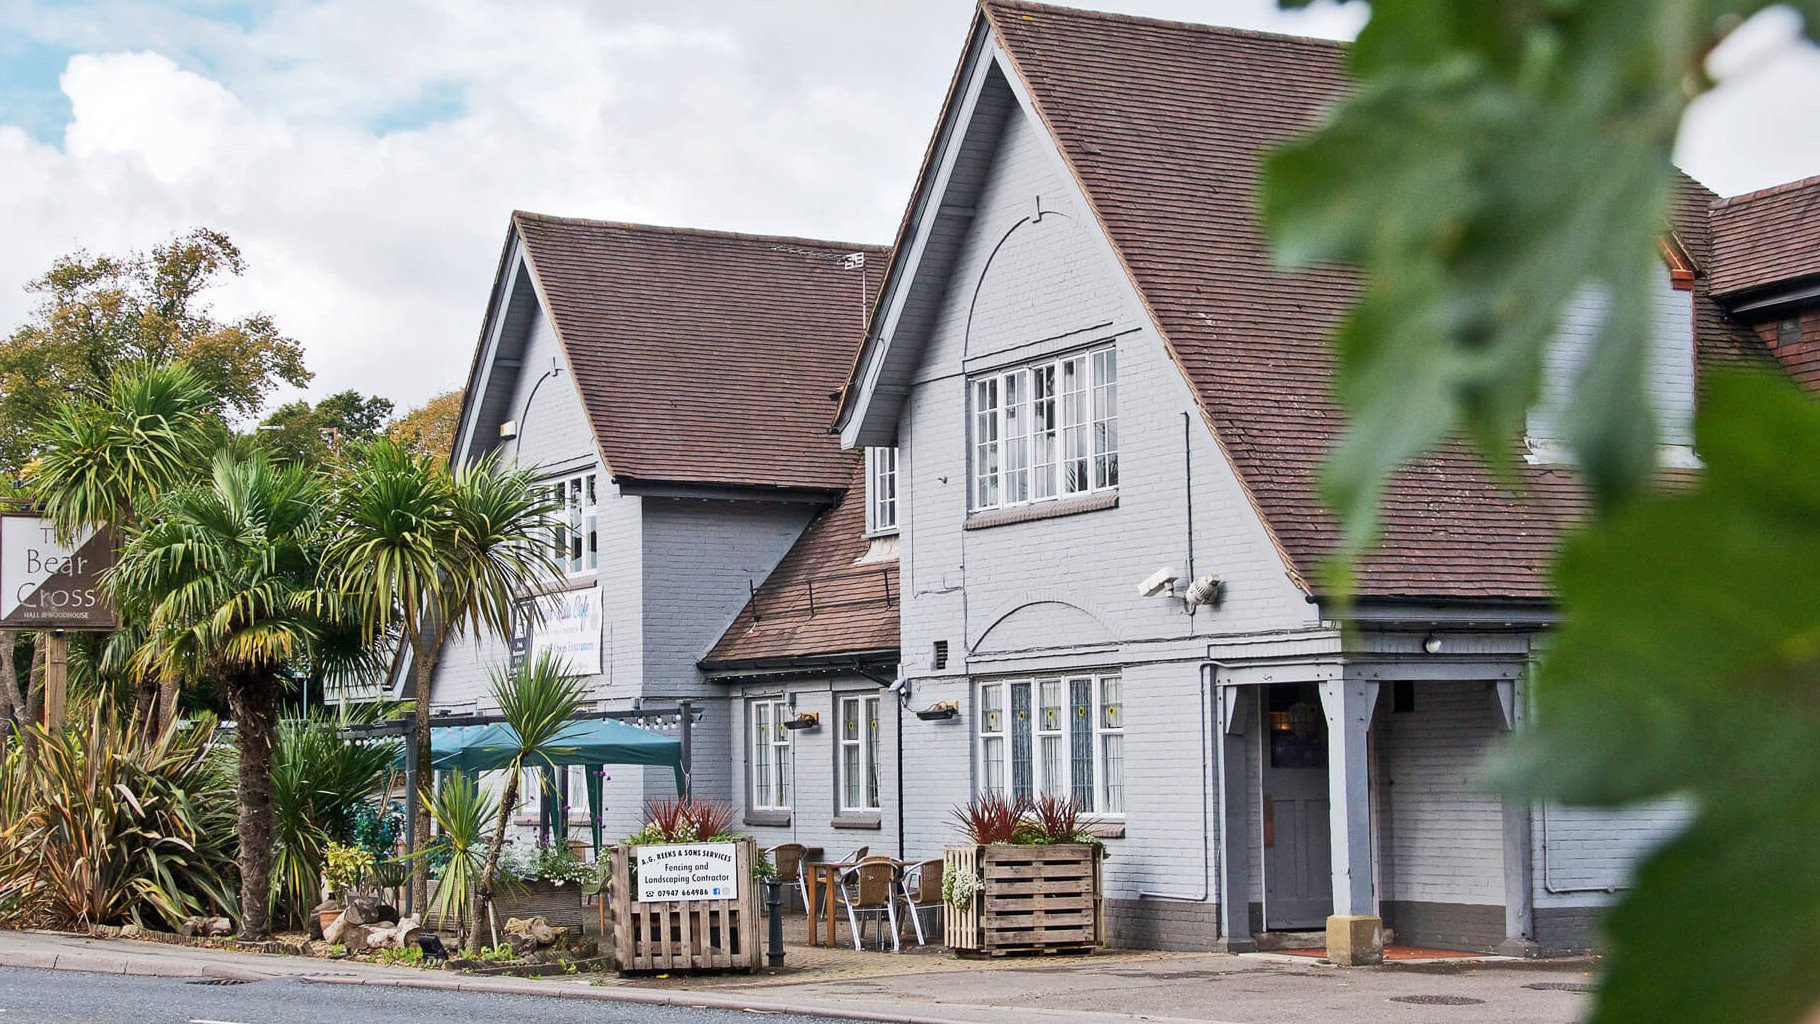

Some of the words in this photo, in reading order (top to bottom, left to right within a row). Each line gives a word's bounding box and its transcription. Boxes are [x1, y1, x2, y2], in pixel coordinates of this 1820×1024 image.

[27, 549, 88, 577] Bear
[16, 582, 96, 608] Cross
[24, 611, 39, 619] HALL
[48, 611, 89, 619] WOODHOUSE
[657, 850, 676, 860] REEKS
[684, 849, 701, 857] SONS
[702, 850, 732, 862] SERVICES
[665, 863, 693, 872] Fencing
[694, 862, 709, 871] and
[645, 875, 690, 884] Landscaping
[692, 873, 730, 882] Contractor
[681, 888, 709, 896] 664986
